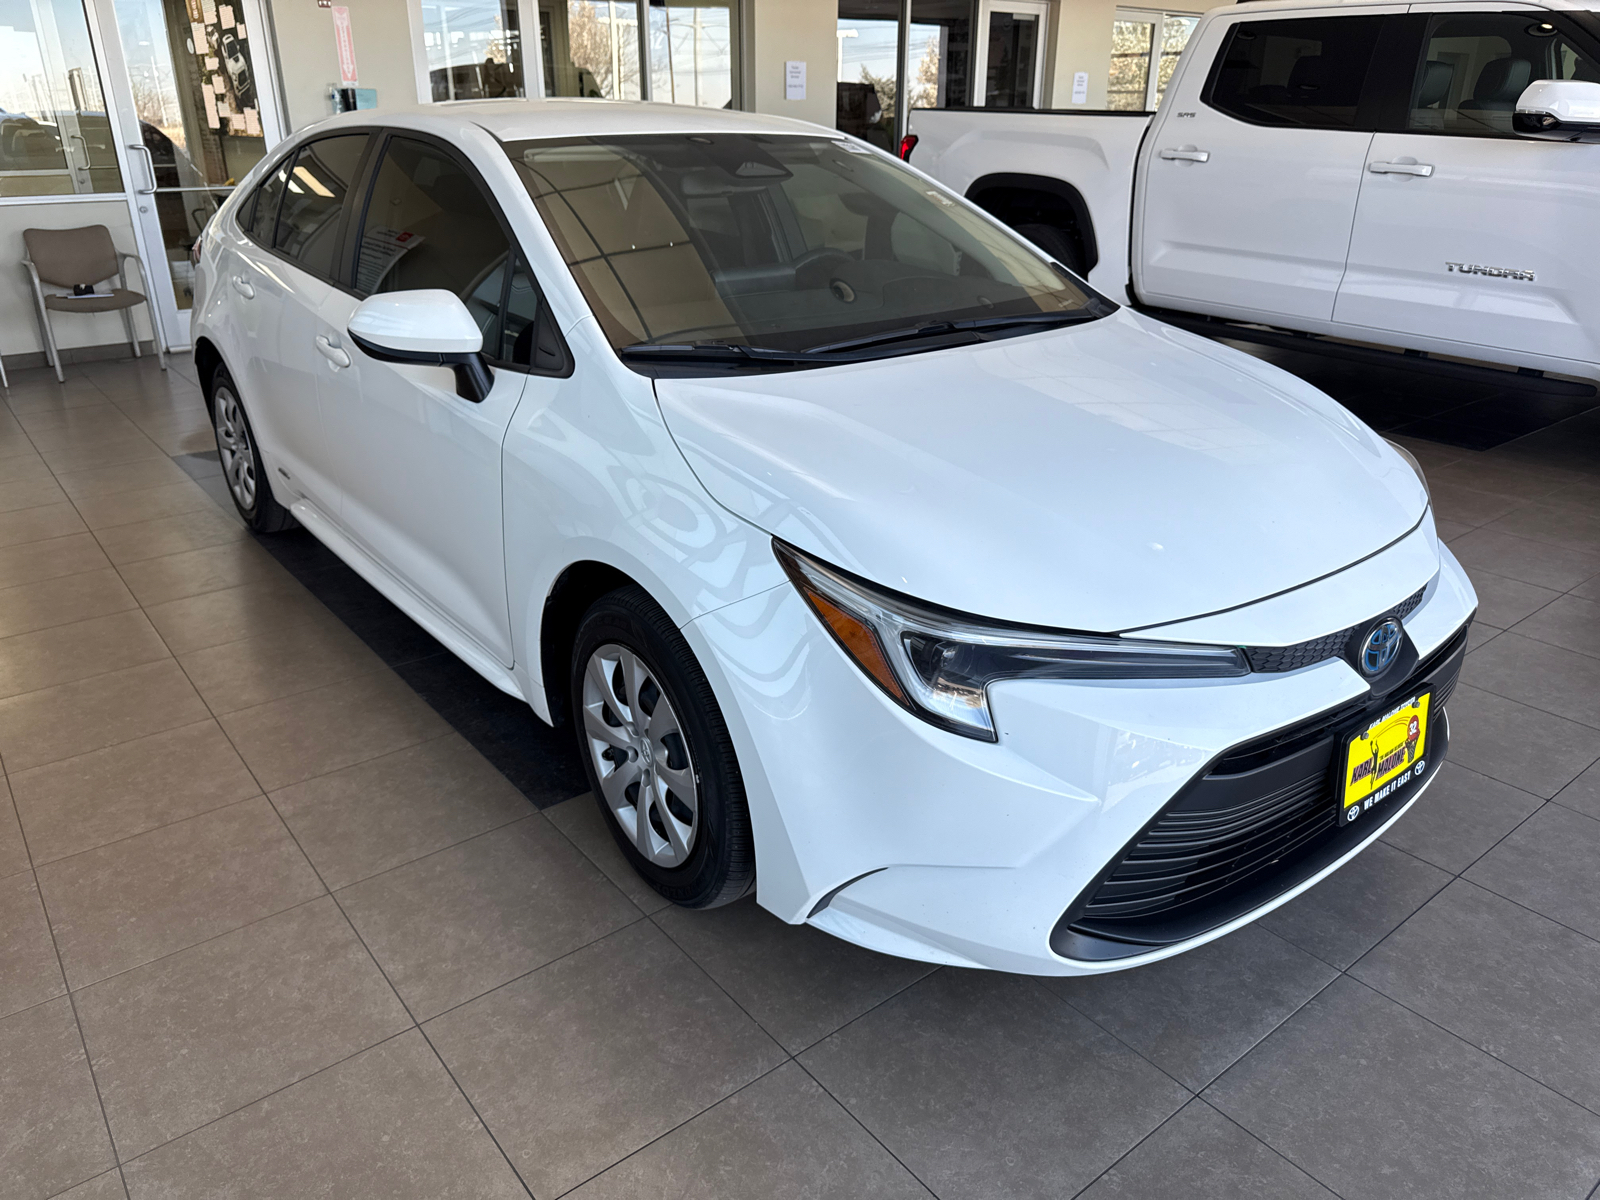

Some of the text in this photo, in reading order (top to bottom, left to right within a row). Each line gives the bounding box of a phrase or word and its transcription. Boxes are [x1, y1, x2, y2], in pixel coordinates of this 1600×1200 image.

[1445, 261, 1535, 282] TUNDRA
[1409, 720, 1418, 736] 32
[1350, 757, 1374, 787] KARL
[1375, 745, 1406, 781] MALONE
[1364, 770, 1411, 810] WE MAKE IT EASY
